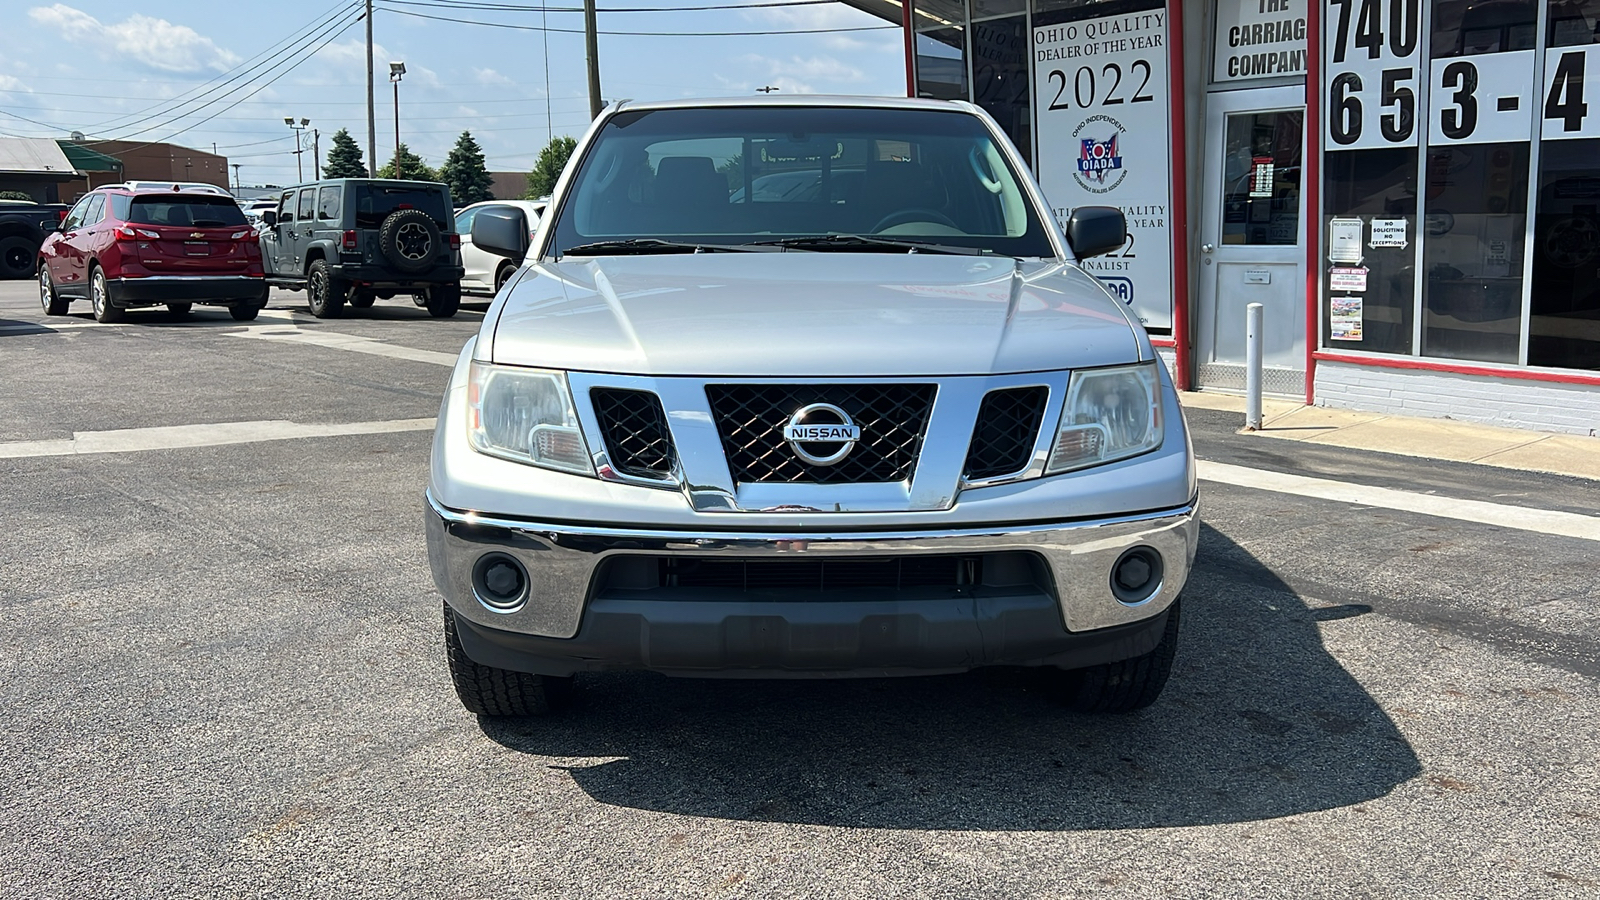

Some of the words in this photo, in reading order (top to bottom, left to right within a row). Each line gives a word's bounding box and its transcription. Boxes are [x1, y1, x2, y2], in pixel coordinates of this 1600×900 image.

[1035, 26, 1078, 45] OHIO
[1085, 13, 1164, 40] QUALITY
[1229, 18, 1308, 48] CARRIAG
[1330, 0, 1418, 63] 740
[1037, 45, 1081, 62] DEALER
[1084, 42, 1100, 56] OF
[1102, 39, 1127, 54] THE
[1129, 34, 1162, 50] YEAR
[1047, 59, 1153, 111] 2022
[1072, 121, 1086, 138] OHIO
[1086, 114, 1127, 134] INDEPENDENT
[1082, 158, 1115, 170] OIADA
[1118, 205, 1166, 216] UALITY
[1134, 219, 1165, 228] YEAR
[1082, 262, 1131, 271] INALIST
[792, 428, 853, 438] NISSAN
